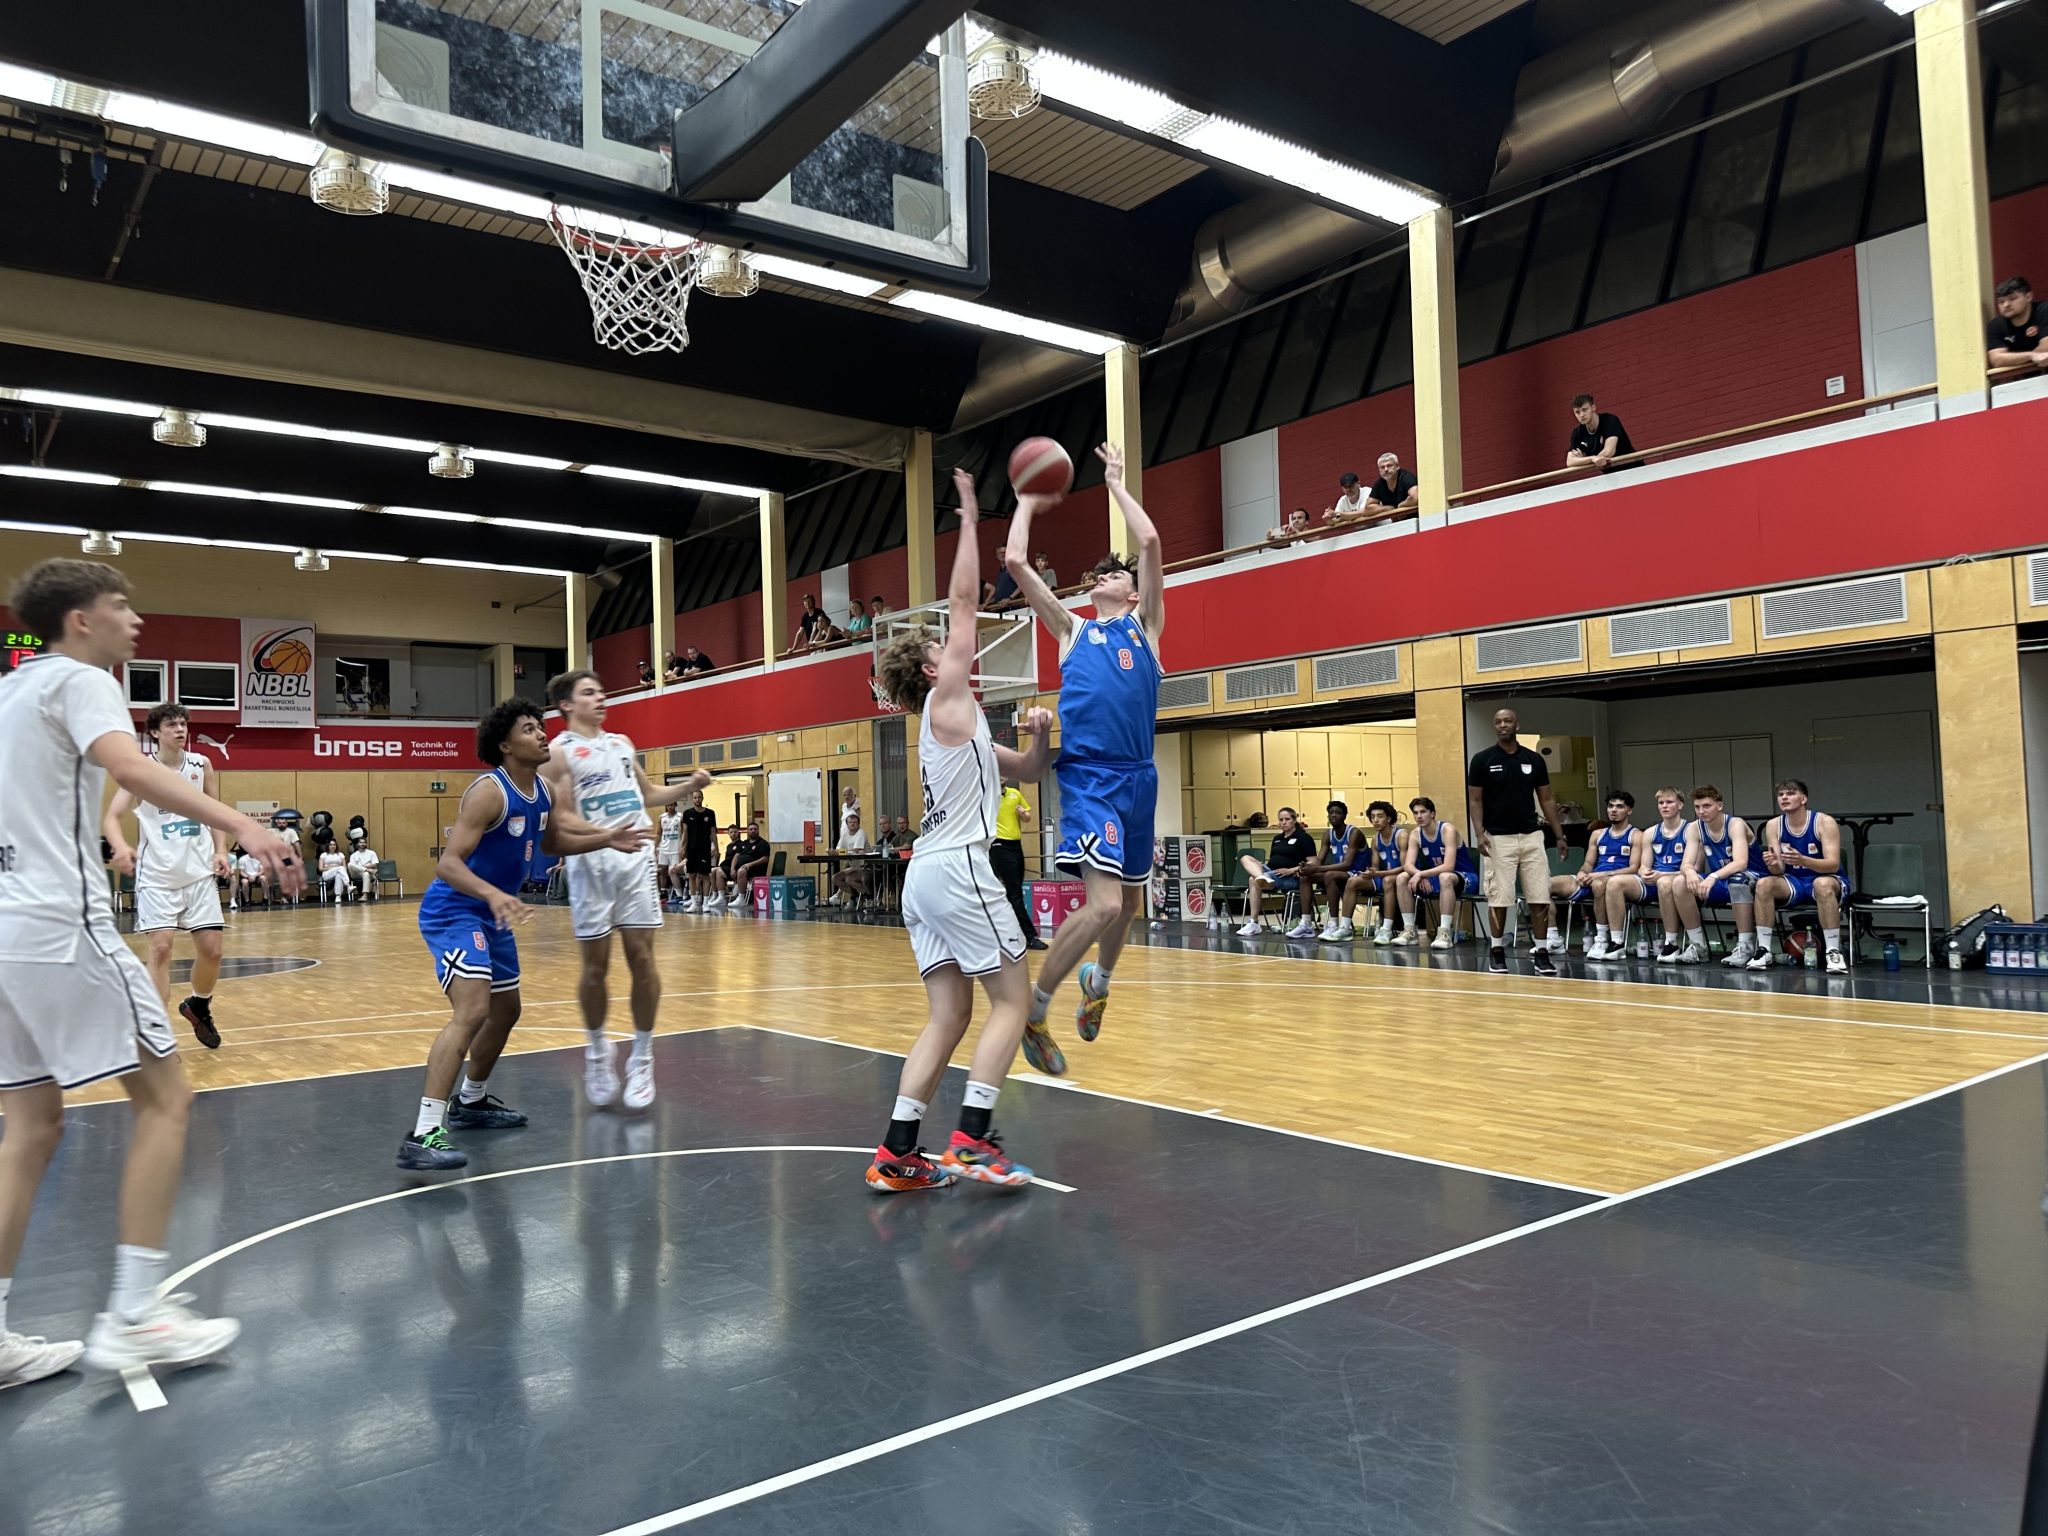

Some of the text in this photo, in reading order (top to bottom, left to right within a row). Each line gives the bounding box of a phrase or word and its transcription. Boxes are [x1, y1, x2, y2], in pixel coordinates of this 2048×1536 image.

[1118, 648, 1134, 670] 8
[246, 672, 312, 697] NBBL
[314, 733, 403, 757] brose
[411, 741, 458, 749] Technik für
[411, 749, 459, 758] Automobile
[1105, 821, 1118, 845] 8
[1060, 883, 1087, 892] saniklic
[472, 931, 486, 951] 5
[904, 1166, 916, 1177] 13
